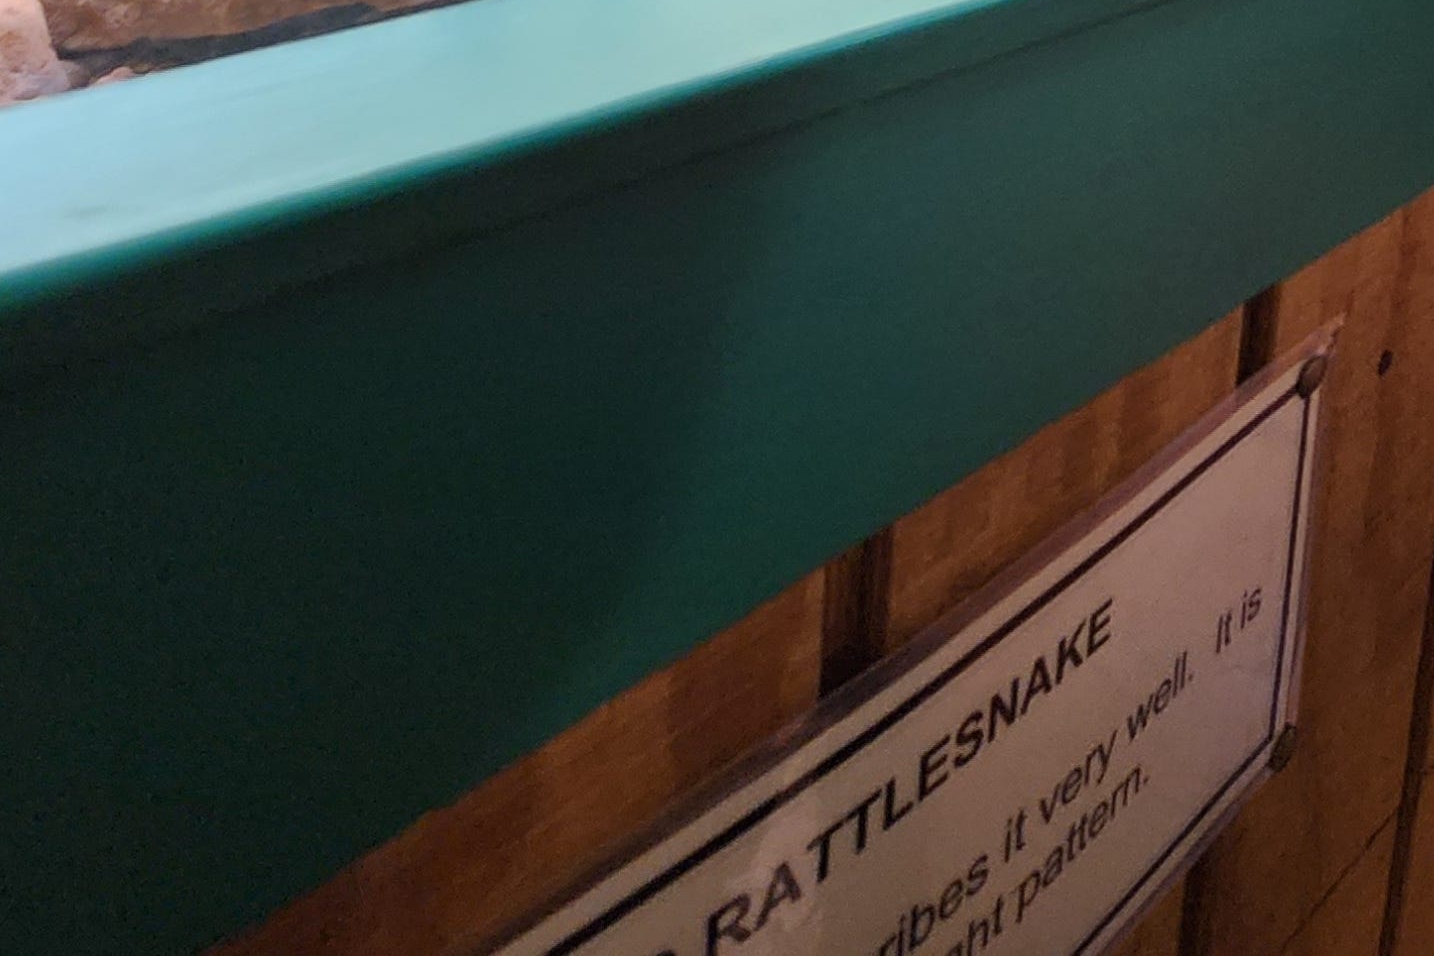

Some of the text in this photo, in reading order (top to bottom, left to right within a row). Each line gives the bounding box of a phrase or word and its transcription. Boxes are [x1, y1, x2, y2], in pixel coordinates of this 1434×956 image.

[704, 598, 1113, 956] RATTLESNAKE
[1003, 810, 1027, 863] it
[1039, 730, 1118, 824] very
[1126, 650, 1194, 742] well.
[1215, 610, 1232, 655] It
[1240, 587, 1262, 629] is
[1015, 764, 1150, 923] pattern.
